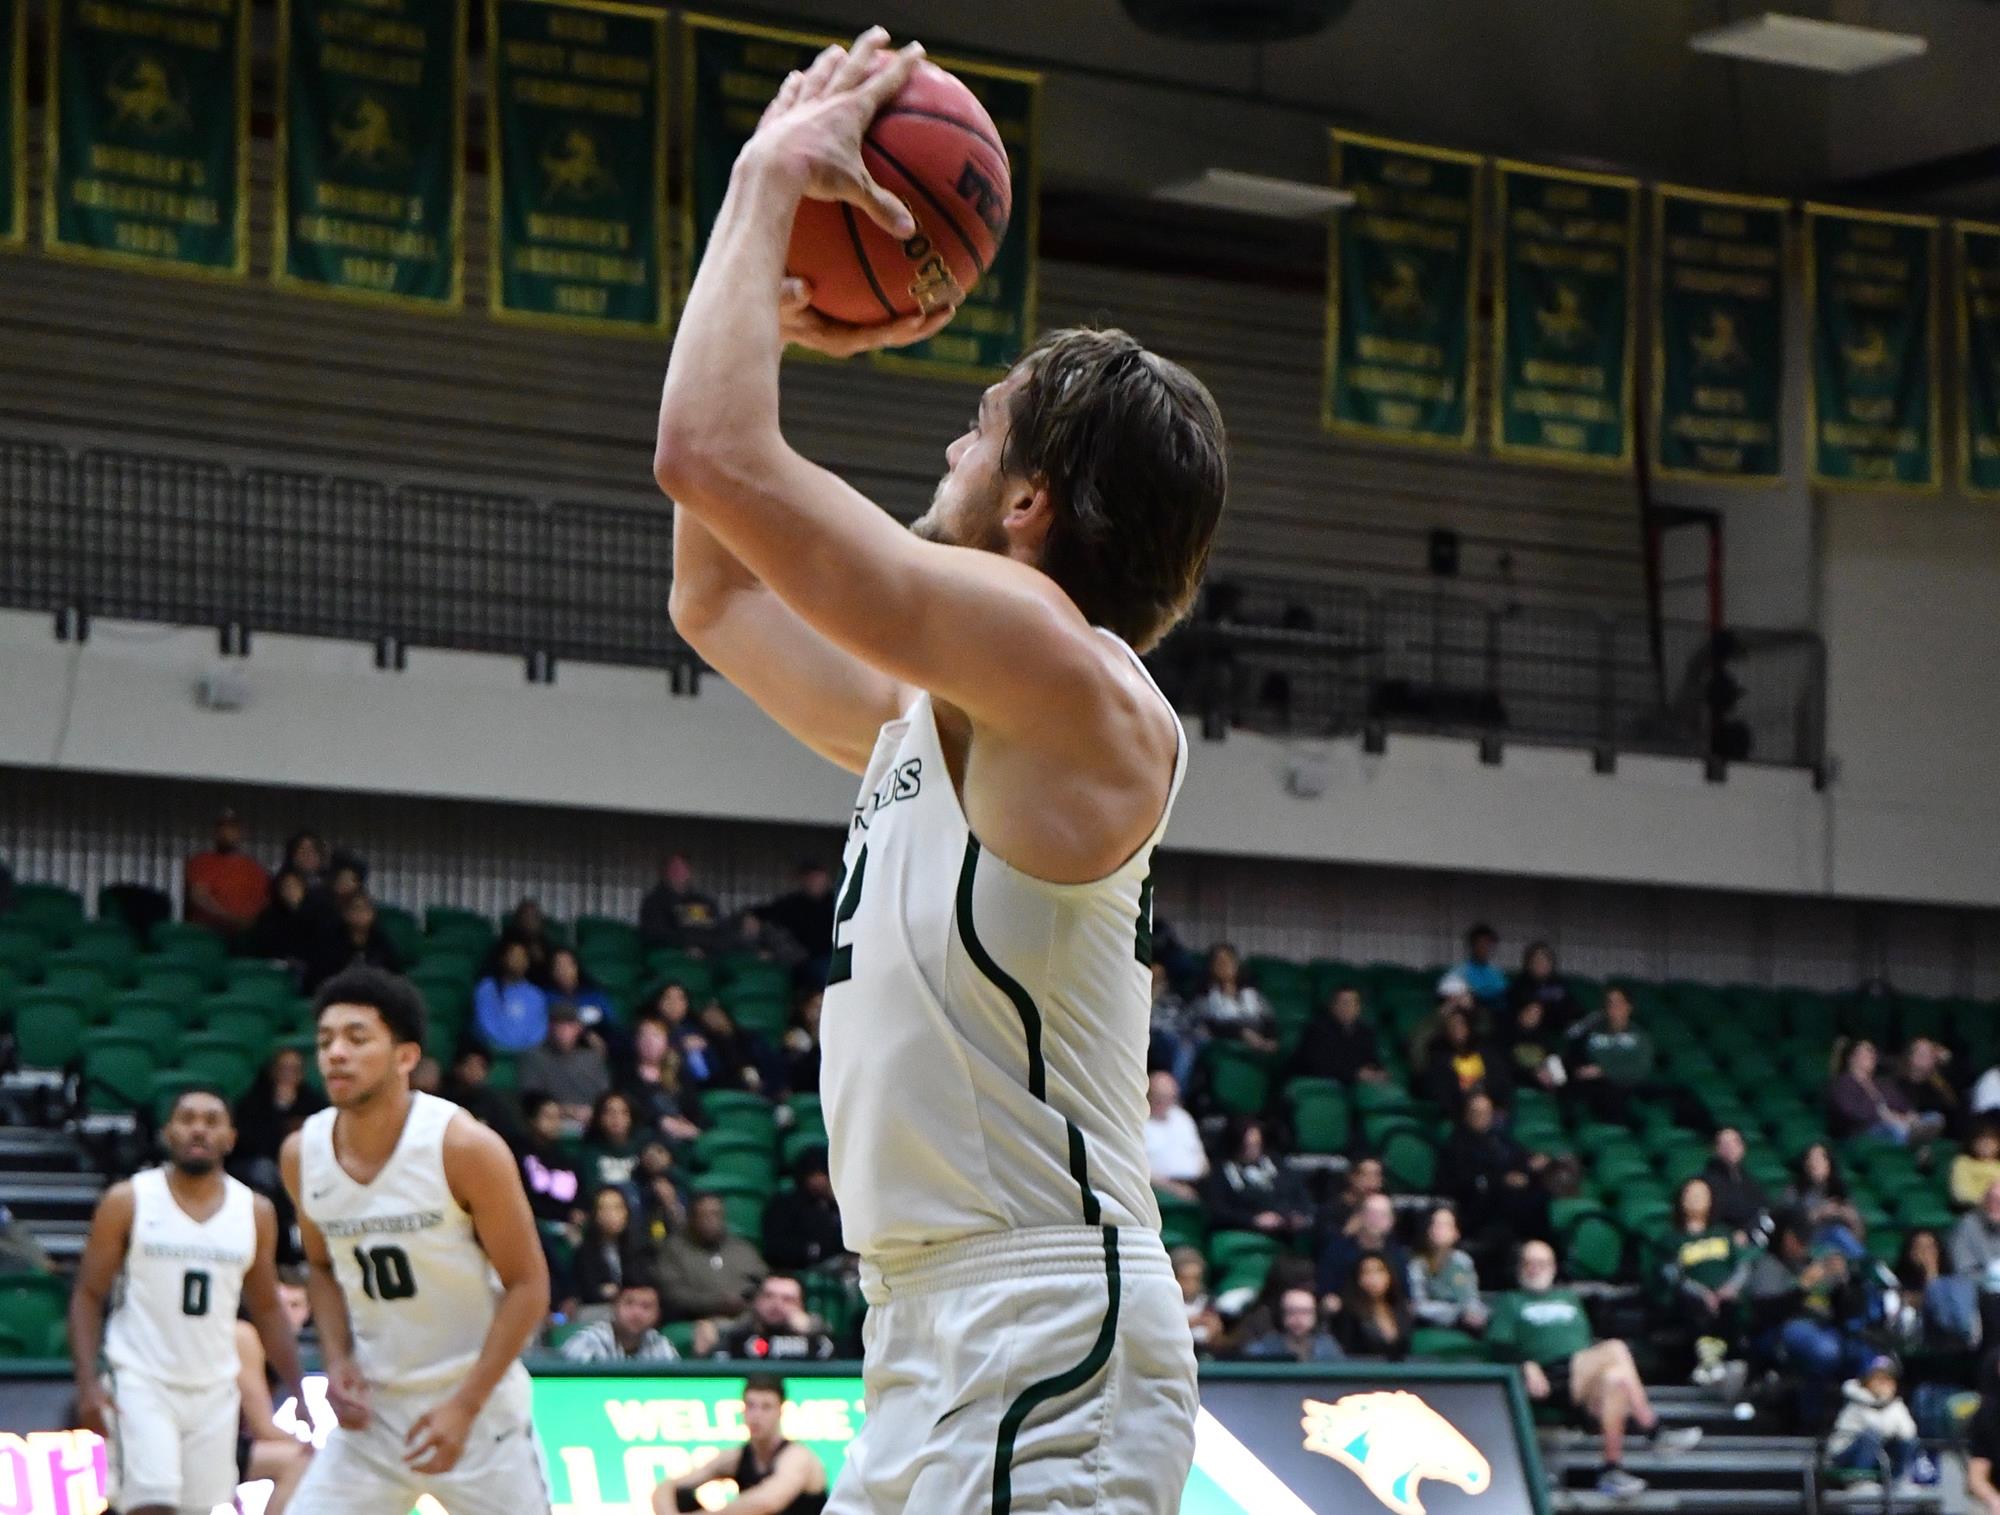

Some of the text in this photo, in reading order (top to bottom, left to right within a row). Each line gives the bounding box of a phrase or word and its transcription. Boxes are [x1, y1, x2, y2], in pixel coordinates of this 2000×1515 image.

[183, 1269, 209, 1316] 0
[354, 1245, 418, 1300] 10
[604, 1398, 855, 1442] WELCME
